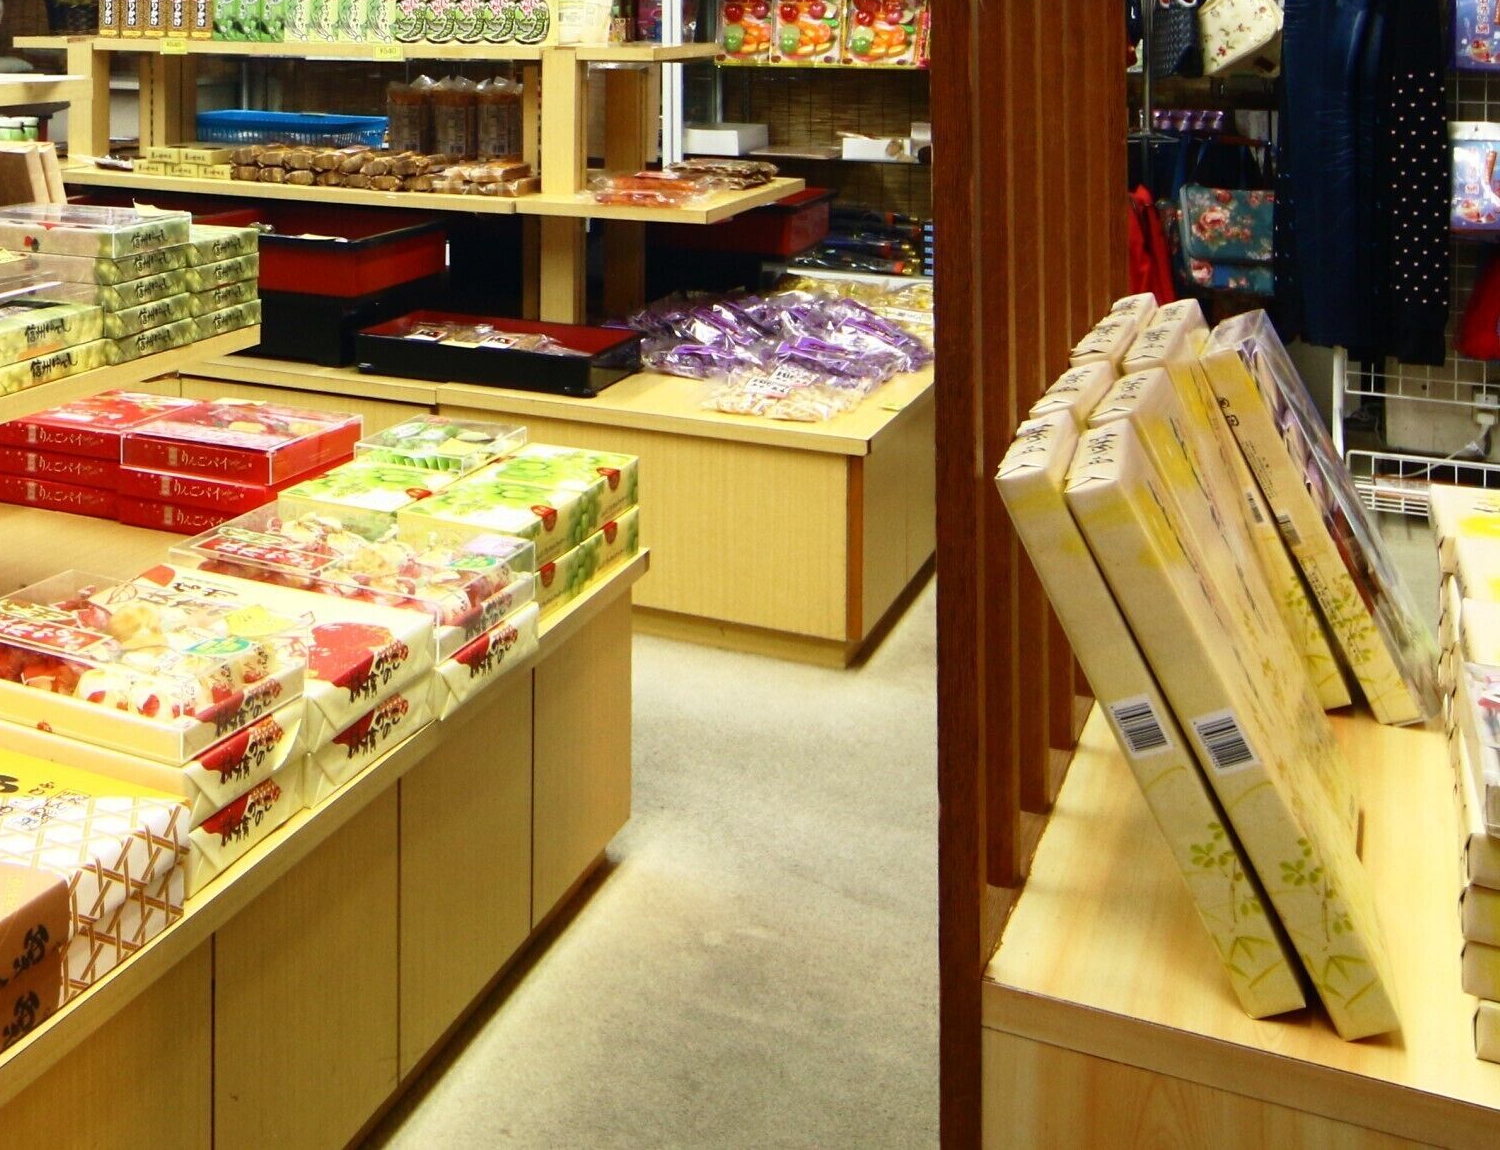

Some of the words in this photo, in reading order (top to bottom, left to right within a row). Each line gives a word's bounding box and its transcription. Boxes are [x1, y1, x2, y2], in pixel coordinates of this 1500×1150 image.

[24, 317, 72, 343] 信州ゆべし
[30, 352, 78, 379] 信州ゆべし
[39, 427, 82, 445] りんごパイ
[39, 455, 82, 474] りんごパイ
[181, 450, 230, 470] りんごパイ
[39, 484, 82, 503] りんごパイ
[173, 478, 222, 499] りんごパイ
